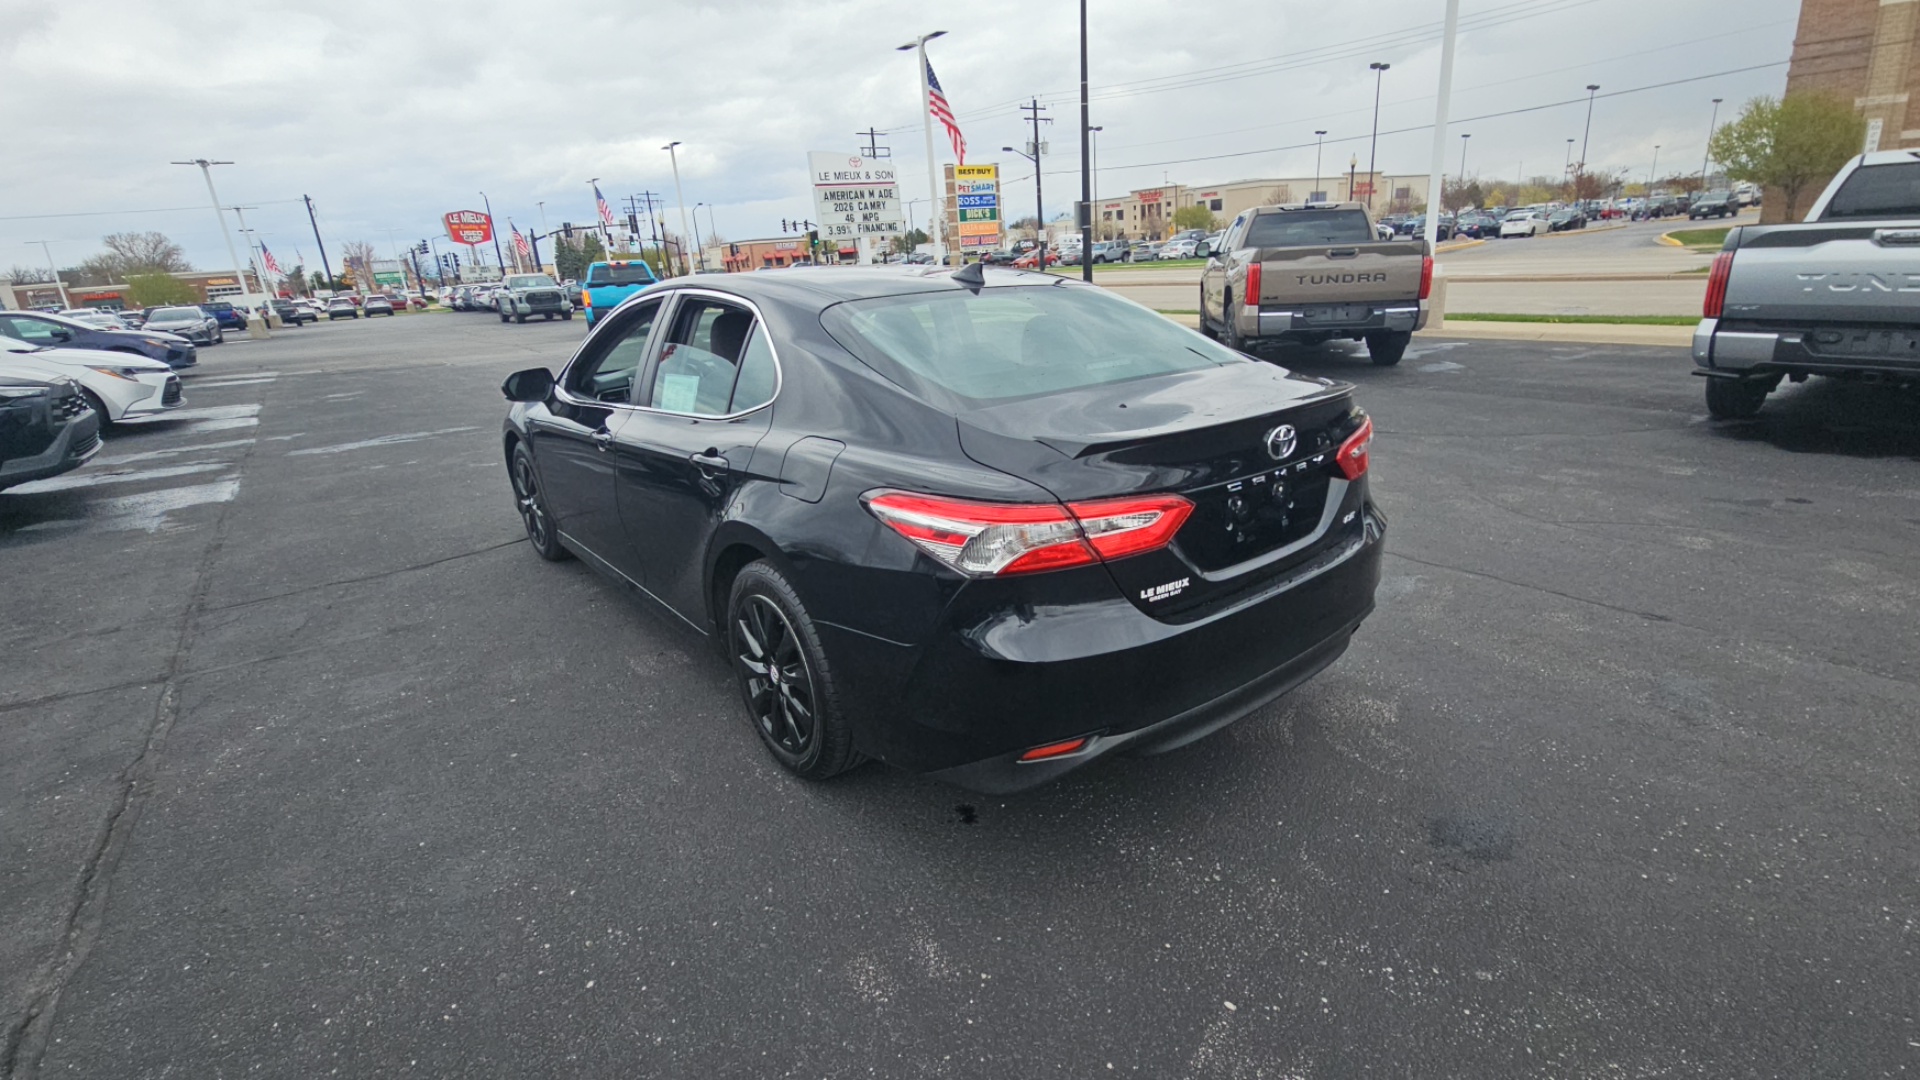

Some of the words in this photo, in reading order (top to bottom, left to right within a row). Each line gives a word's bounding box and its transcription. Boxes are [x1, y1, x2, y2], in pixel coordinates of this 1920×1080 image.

[819, 171, 830, 181] LE
[834, 171, 861, 180] MIEUX
[865, 171, 871, 179] &
[875, 170, 893, 179] SON
[824, 190, 865, 201] AMERICAN
[958, 196, 980, 205] ROSS
[834, 202, 854, 212] 2026
[858, 201, 886, 211] CAMRY
[448, 213, 460, 223] LE
[460, 211, 486, 223] MIEUX
[845, 213, 855, 222] 46
[862, 212, 879, 221] MPG
[966, 208, 990, 219] DICK'S
[828, 225, 852, 235] 3.99%
[857, 222, 897, 233] FINANCING
[1296, 272, 1386, 285] TUNDRA
[1227, 455, 1324, 492] CAMRY
[1140, 588, 1155, 599] LE
[1156, 577, 1189, 595] MIEUX
[1149, 592, 1169, 602] GREEN
[1170, 588, 1181, 596] BAY
